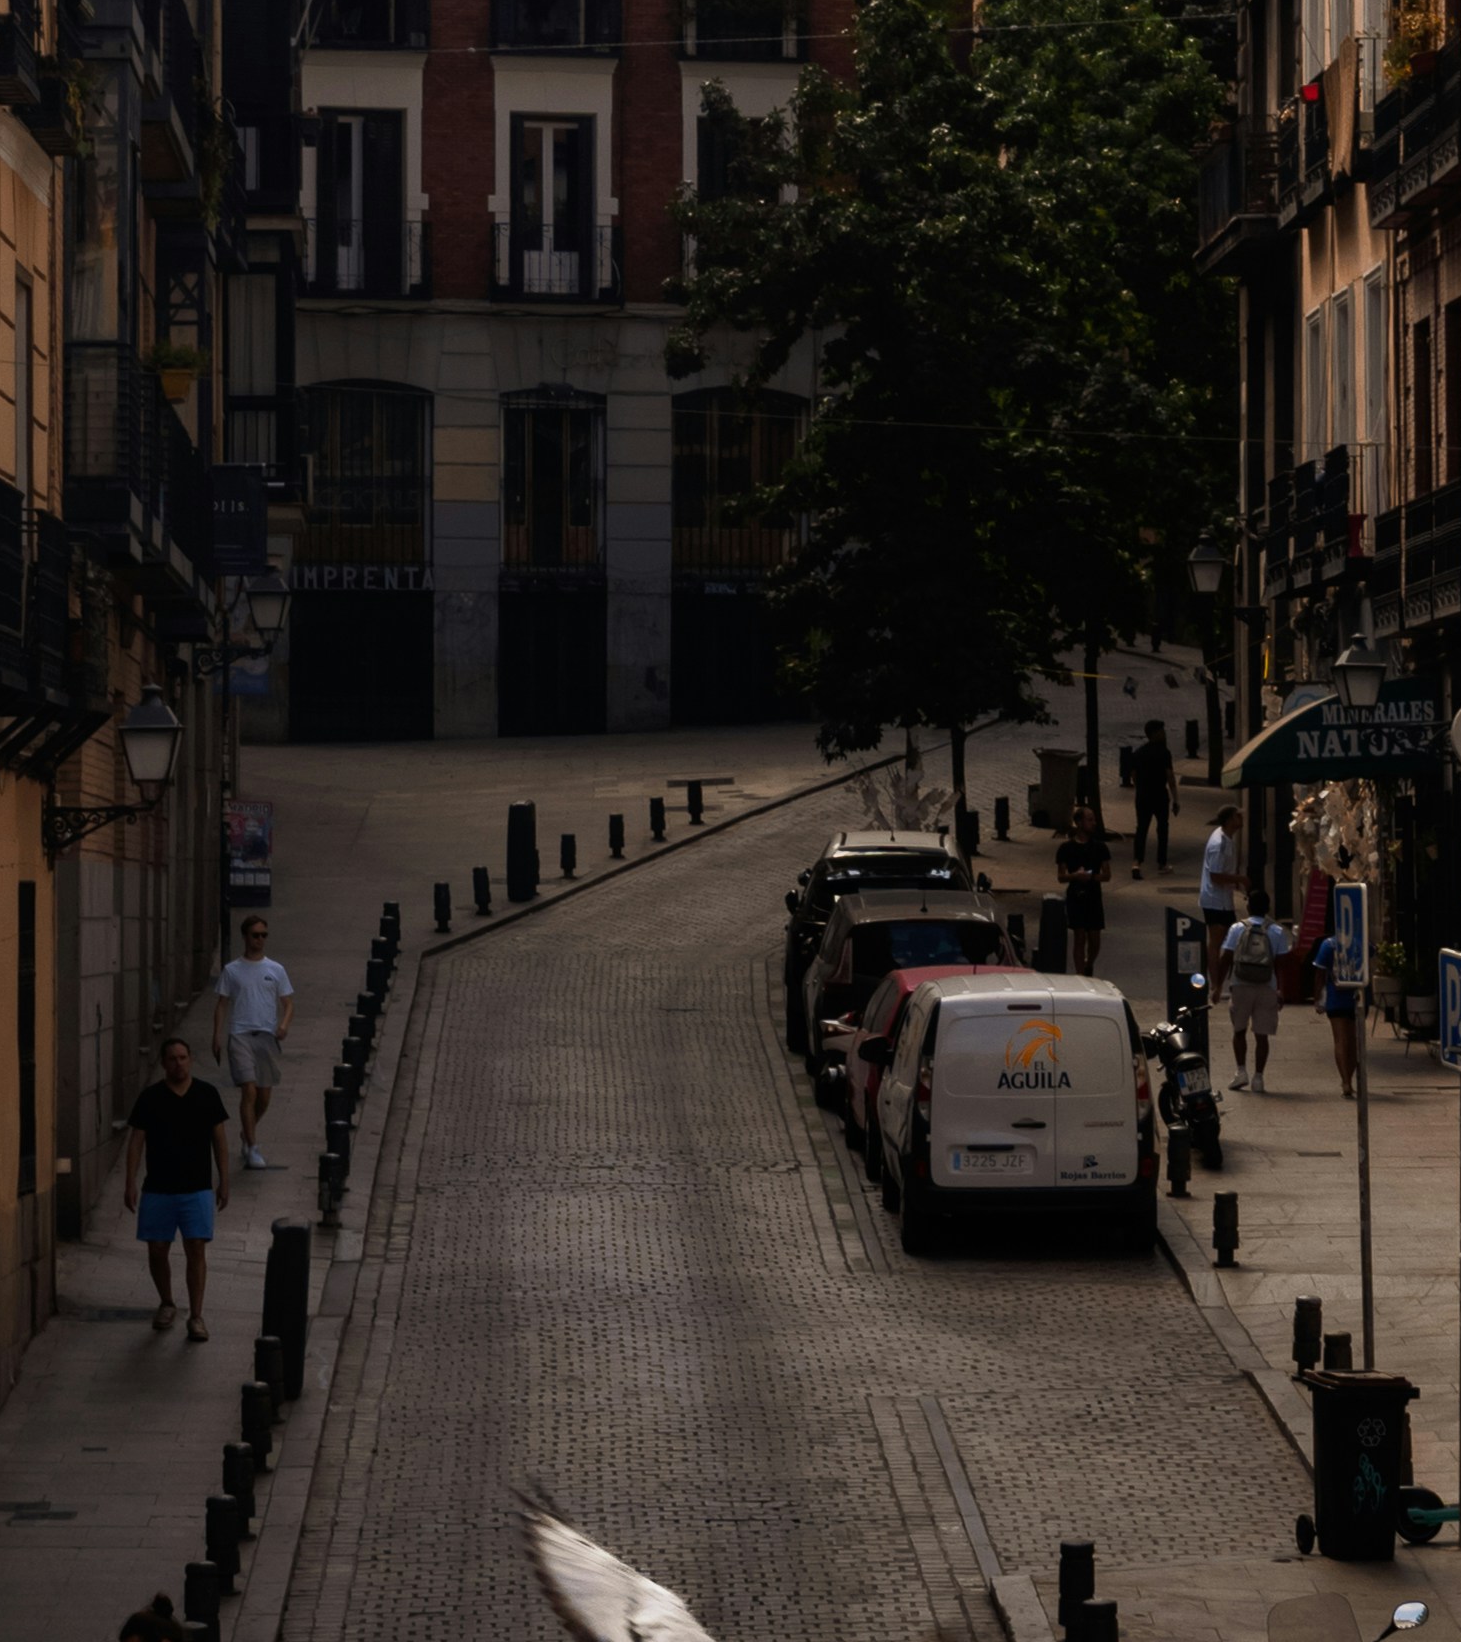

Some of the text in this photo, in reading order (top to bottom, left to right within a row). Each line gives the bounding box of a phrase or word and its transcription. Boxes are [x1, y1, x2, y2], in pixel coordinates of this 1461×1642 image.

[293, 566, 435, 591] IMPRENTA
[1321, 700, 1435, 725] MINERALES
[1176, 917, 1191, 937] P
[963, 1153, 1026, 1167] 3225 JZF
